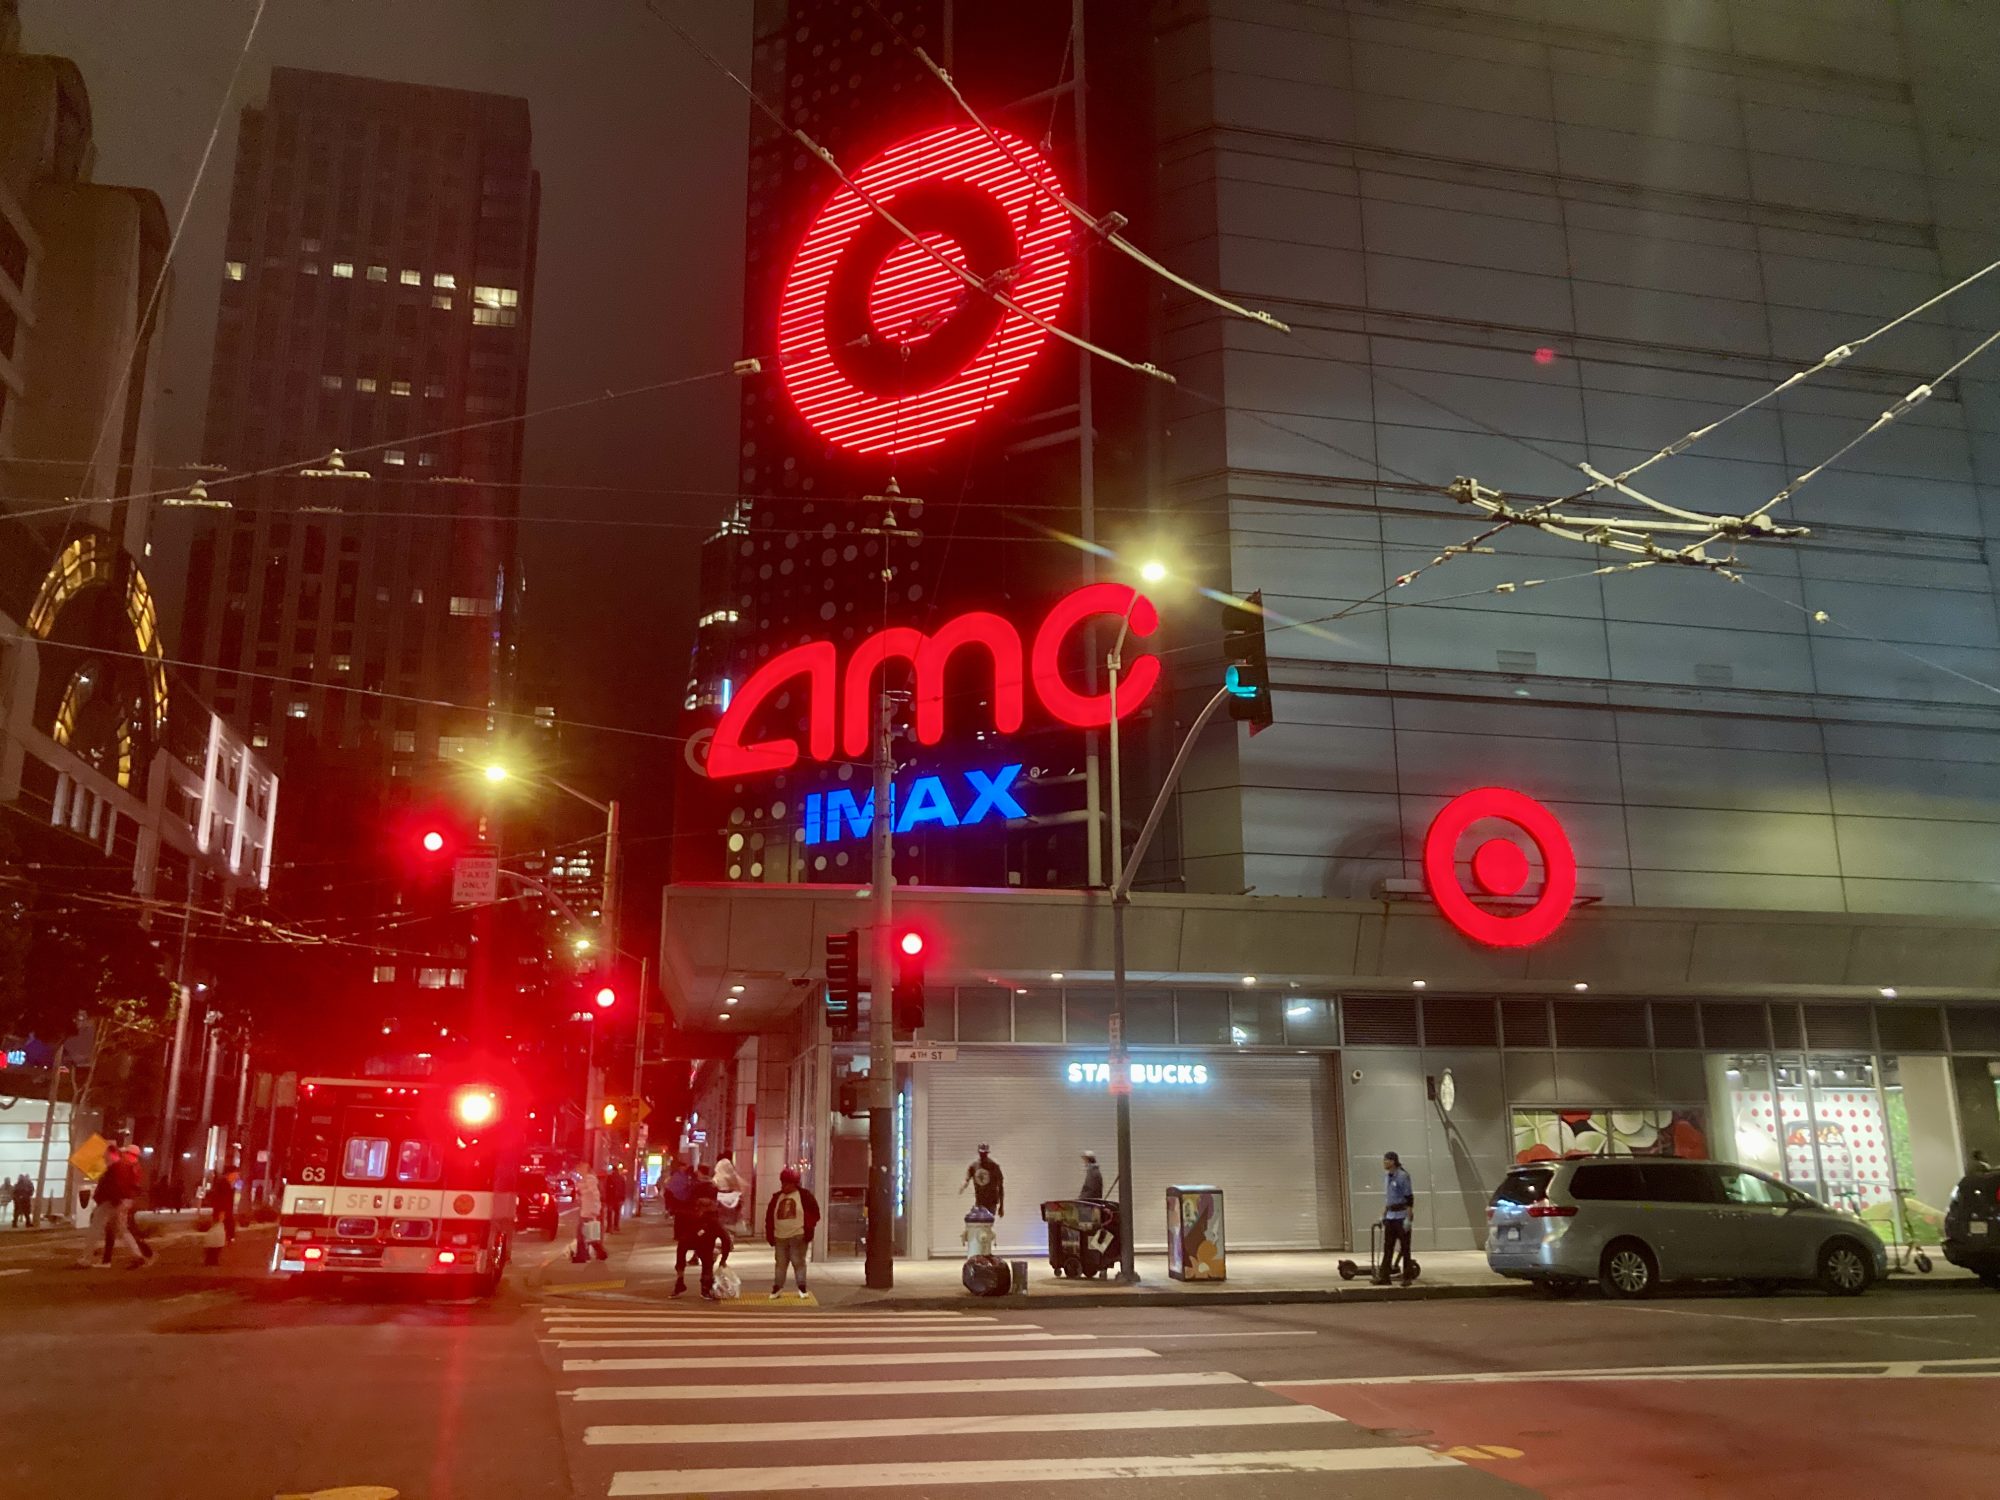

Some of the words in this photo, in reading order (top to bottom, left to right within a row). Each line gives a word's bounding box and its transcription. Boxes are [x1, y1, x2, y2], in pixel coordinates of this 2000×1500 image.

[804, 763, 1028, 845] IMAX
[462, 881, 488, 889] ONLY
[909, 1051, 927, 1060] 4TH
[931, 1051, 943, 1060] ST
[1068, 1062, 1208, 1084] STABUCKS
[301, 1166, 326, 1182] 63
[345, 1193, 369, 1209] SF
[406, 1195, 431, 1211] FD
